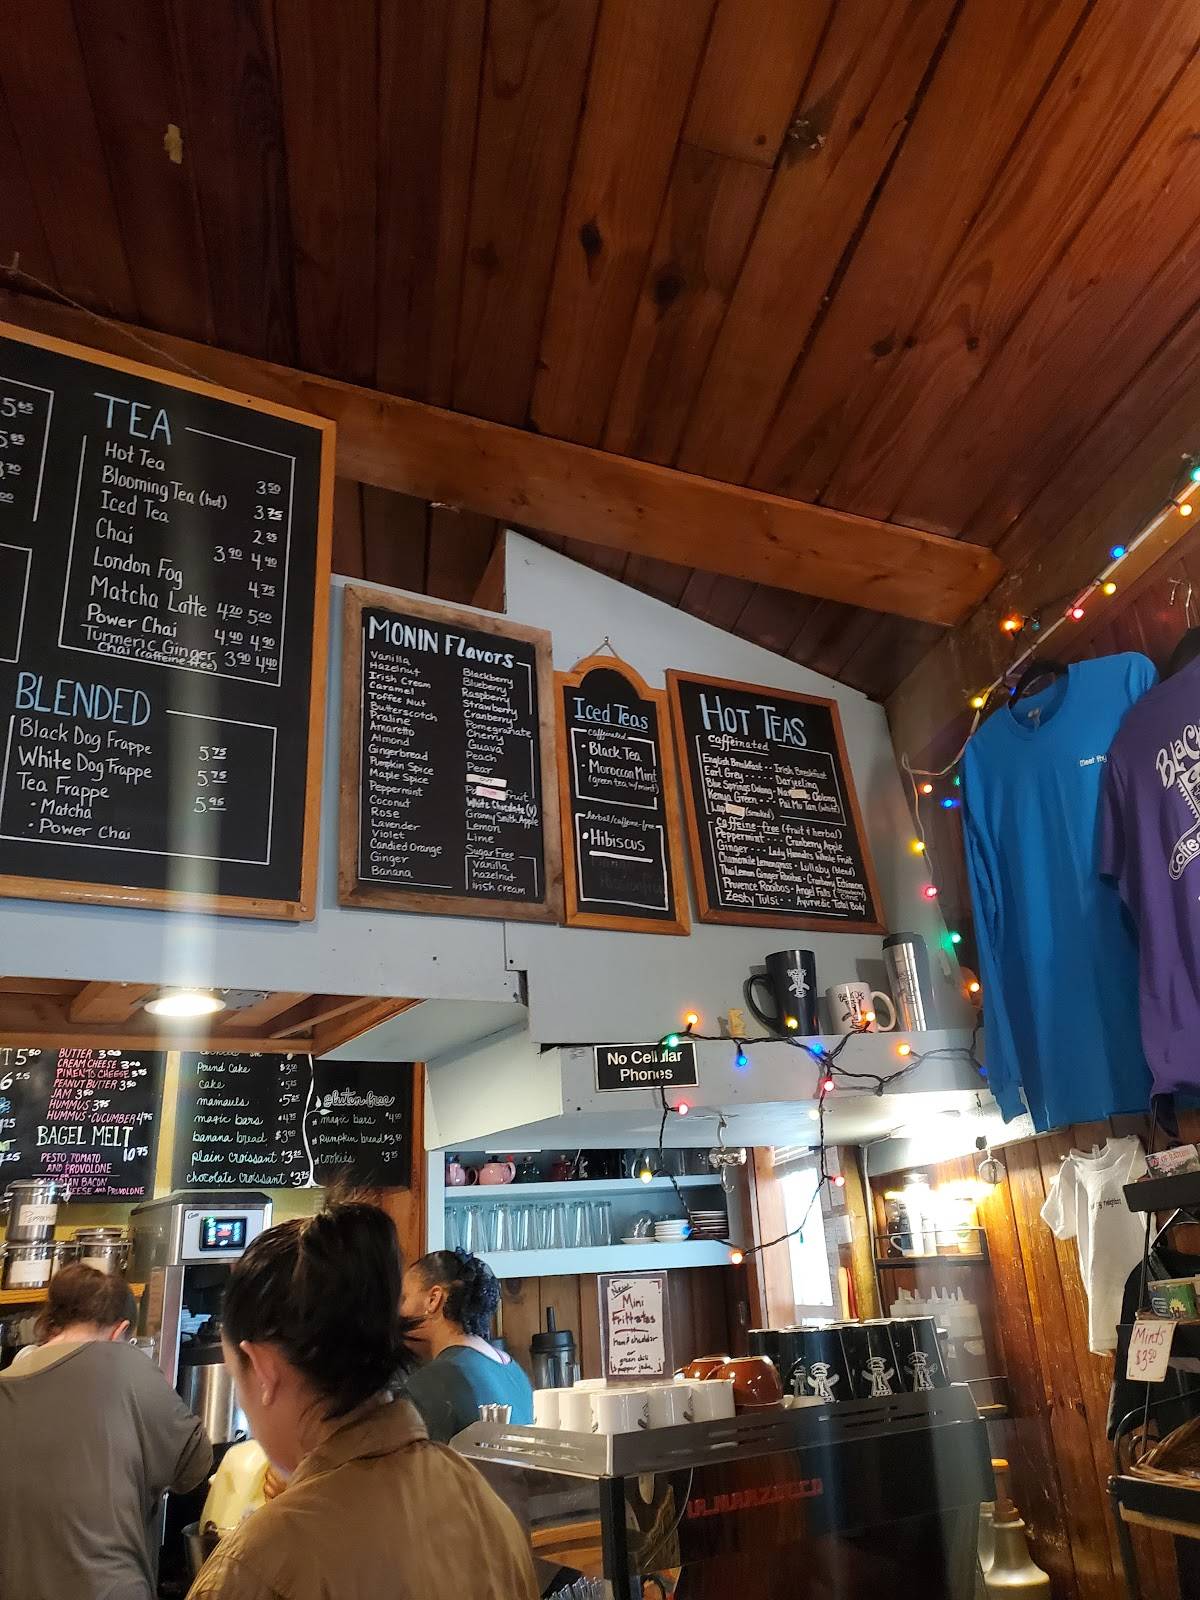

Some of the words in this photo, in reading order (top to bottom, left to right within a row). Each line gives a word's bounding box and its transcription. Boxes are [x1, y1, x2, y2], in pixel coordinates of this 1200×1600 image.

[93, 392, 172, 446] TEA
[105, 441, 135, 463] Hot
[140, 449, 166, 471] Tea
[102, 465, 168, 502] Blooming
[170, 481, 194, 504] Tea
[100, 490, 137, 515] Iced
[144, 500, 169, 522] Tea
[96, 517, 133, 544] Chai
[94, 546, 150, 576] London
[158, 558, 183, 590] Fog
[91, 575, 158, 608] Matcha
[168, 591, 208, 617] Latte
[87, 603, 137, 628] Power
[142, 616, 177, 637] Chai
[80, 623, 157, 649] Turmeric
[162, 640, 217, 663] Ginger
[97, 641, 131, 656] Chai
[368, 615, 439, 655] MONIN
[445, 634, 515, 669] Flavors
[370, 650, 411, 666] Vanilla
[369, 661, 421, 677] Hazelnut
[368, 671, 397, 683] Irish
[401, 677, 431, 689] Cream
[462, 667, 514, 690] Blackberry
[462, 677, 508, 697] Blueberry
[368, 681, 415, 695] Caramel
[15, 672, 151, 726] BLENDED
[368, 691, 402, 704] Toffee
[406, 698, 427, 708] Nut
[461, 687, 510, 708] Raspberry
[369, 709, 411, 726] Praline
[370, 701, 438, 722] Butterscotch
[462, 699, 518, 721] Strawberry
[572, 697, 611, 722] Iced
[613, 703, 649, 730] Teas
[463, 709, 514, 730] Cranberry
[699, 693, 751, 736] HOT
[755, 704, 807, 747] TEAS
[20, 717, 69, 742] Black
[74, 726, 101, 753] Dog
[107, 730, 153, 757] Frappe
[369, 720, 416, 737] Amaretto
[464, 719, 532, 738] Pomegranate
[371, 733, 411, 747] Almond
[466, 729, 504, 746] Cherry
[368, 743, 429, 761] Gingerbread
[467, 739, 504, 755] Guava
[588, 741, 622, 760] Black
[622, 746, 643, 762] Tea
[465, 750, 497, 763] Peach
[18, 746, 72, 771] White
[77, 752, 104, 781] Dog
[105, 758, 153, 785] Frappe
[369, 755, 405, 771] Pumpkin
[407, 762, 434, 776] Spice
[466, 761, 493, 774] Pear
[588, 758, 634, 780] Moroccan
[634, 766, 657, 783] Mint
[369, 767, 400, 782] Maple
[402, 773, 430, 786] Spice
[704, 765, 723, 778] Earl
[724, 767, 744, 784] Grey
[16, 771, 48, 792] Tea
[56, 776, 110, 807] Frappe
[368, 780, 424, 797] Peppermint
[40, 799, 92, 819] Matcha
[369, 794, 412, 809] Coconut
[371, 806, 400, 819] Rose
[39, 818, 92, 834] Power
[98, 825, 131, 840] Chai
[371, 818, 421, 831] Lavender
[466, 820, 501, 833] Lemon
[371, 829, 406, 840] Violet
[466, 833, 495, 844] Lime
[590, 828, 646, 852] Hibiscus
[715, 826, 765, 843] Peppermint
[370, 837, 408, 852] Candied
[409, 842, 442, 858] Orange
[465, 845, 495, 860] Sugar
[495, 848, 516, 859] Free
[717, 839, 748, 857] Ginger
[370, 851, 410, 867] Ginger
[371, 865, 414, 879] Banana
[472, 869, 517, 882] hazelnut
[497, 883, 526, 895] cream
[724, 889, 755, 907] Zesty
[755, 893, 780, 906] Tulsi
[58, 1048, 93, 1059] BUTTER
[607, 1052, 628, 1065] No
[57, 1059, 87, 1069] CREAM
[87, 1059, 117, 1070] CHEESE
[97, 1070, 130, 1079] CHEESE
[620, 1068, 674, 1082] Phones
[53, 1079, 86, 1089] PEANUT
[86, 1080, 118, 1090] BUTTER
[51, 1088, 72, 1099] JAM
[48, 1099, 92, 1110] HUMMUS
[46, 1111, 87, 1121] HUMMUS
[90, 1112, 137, 1125] CUCUMBER
[193, 1114, 231, 1125] magic
[235, 1114, 263, 1126] bars
[36, 1125, 87, 1146] BAGEL
[91, 1125, 134, 1148] MELT
[192, 1130, 233, 1143] banana
[236, 1131, 267, 1144] bread
[70, 1152, 101, 1163] TOMATO
[191, 1149, 225, 1166] plain
[228, 1150, 278, 1164] croissant
[46, 1164, 63, 1172] AND
[64, 1163, 113, 1174] PROVOLONE
[81, 1177, 108, 1187] BACON
[186, 1170, 237, 1184] chocolate
[238, 1171, 288, 1185] croissant
[622, 1294, 645, 1309] Mini
[1133, 1327, 1167, 1346] Mints
